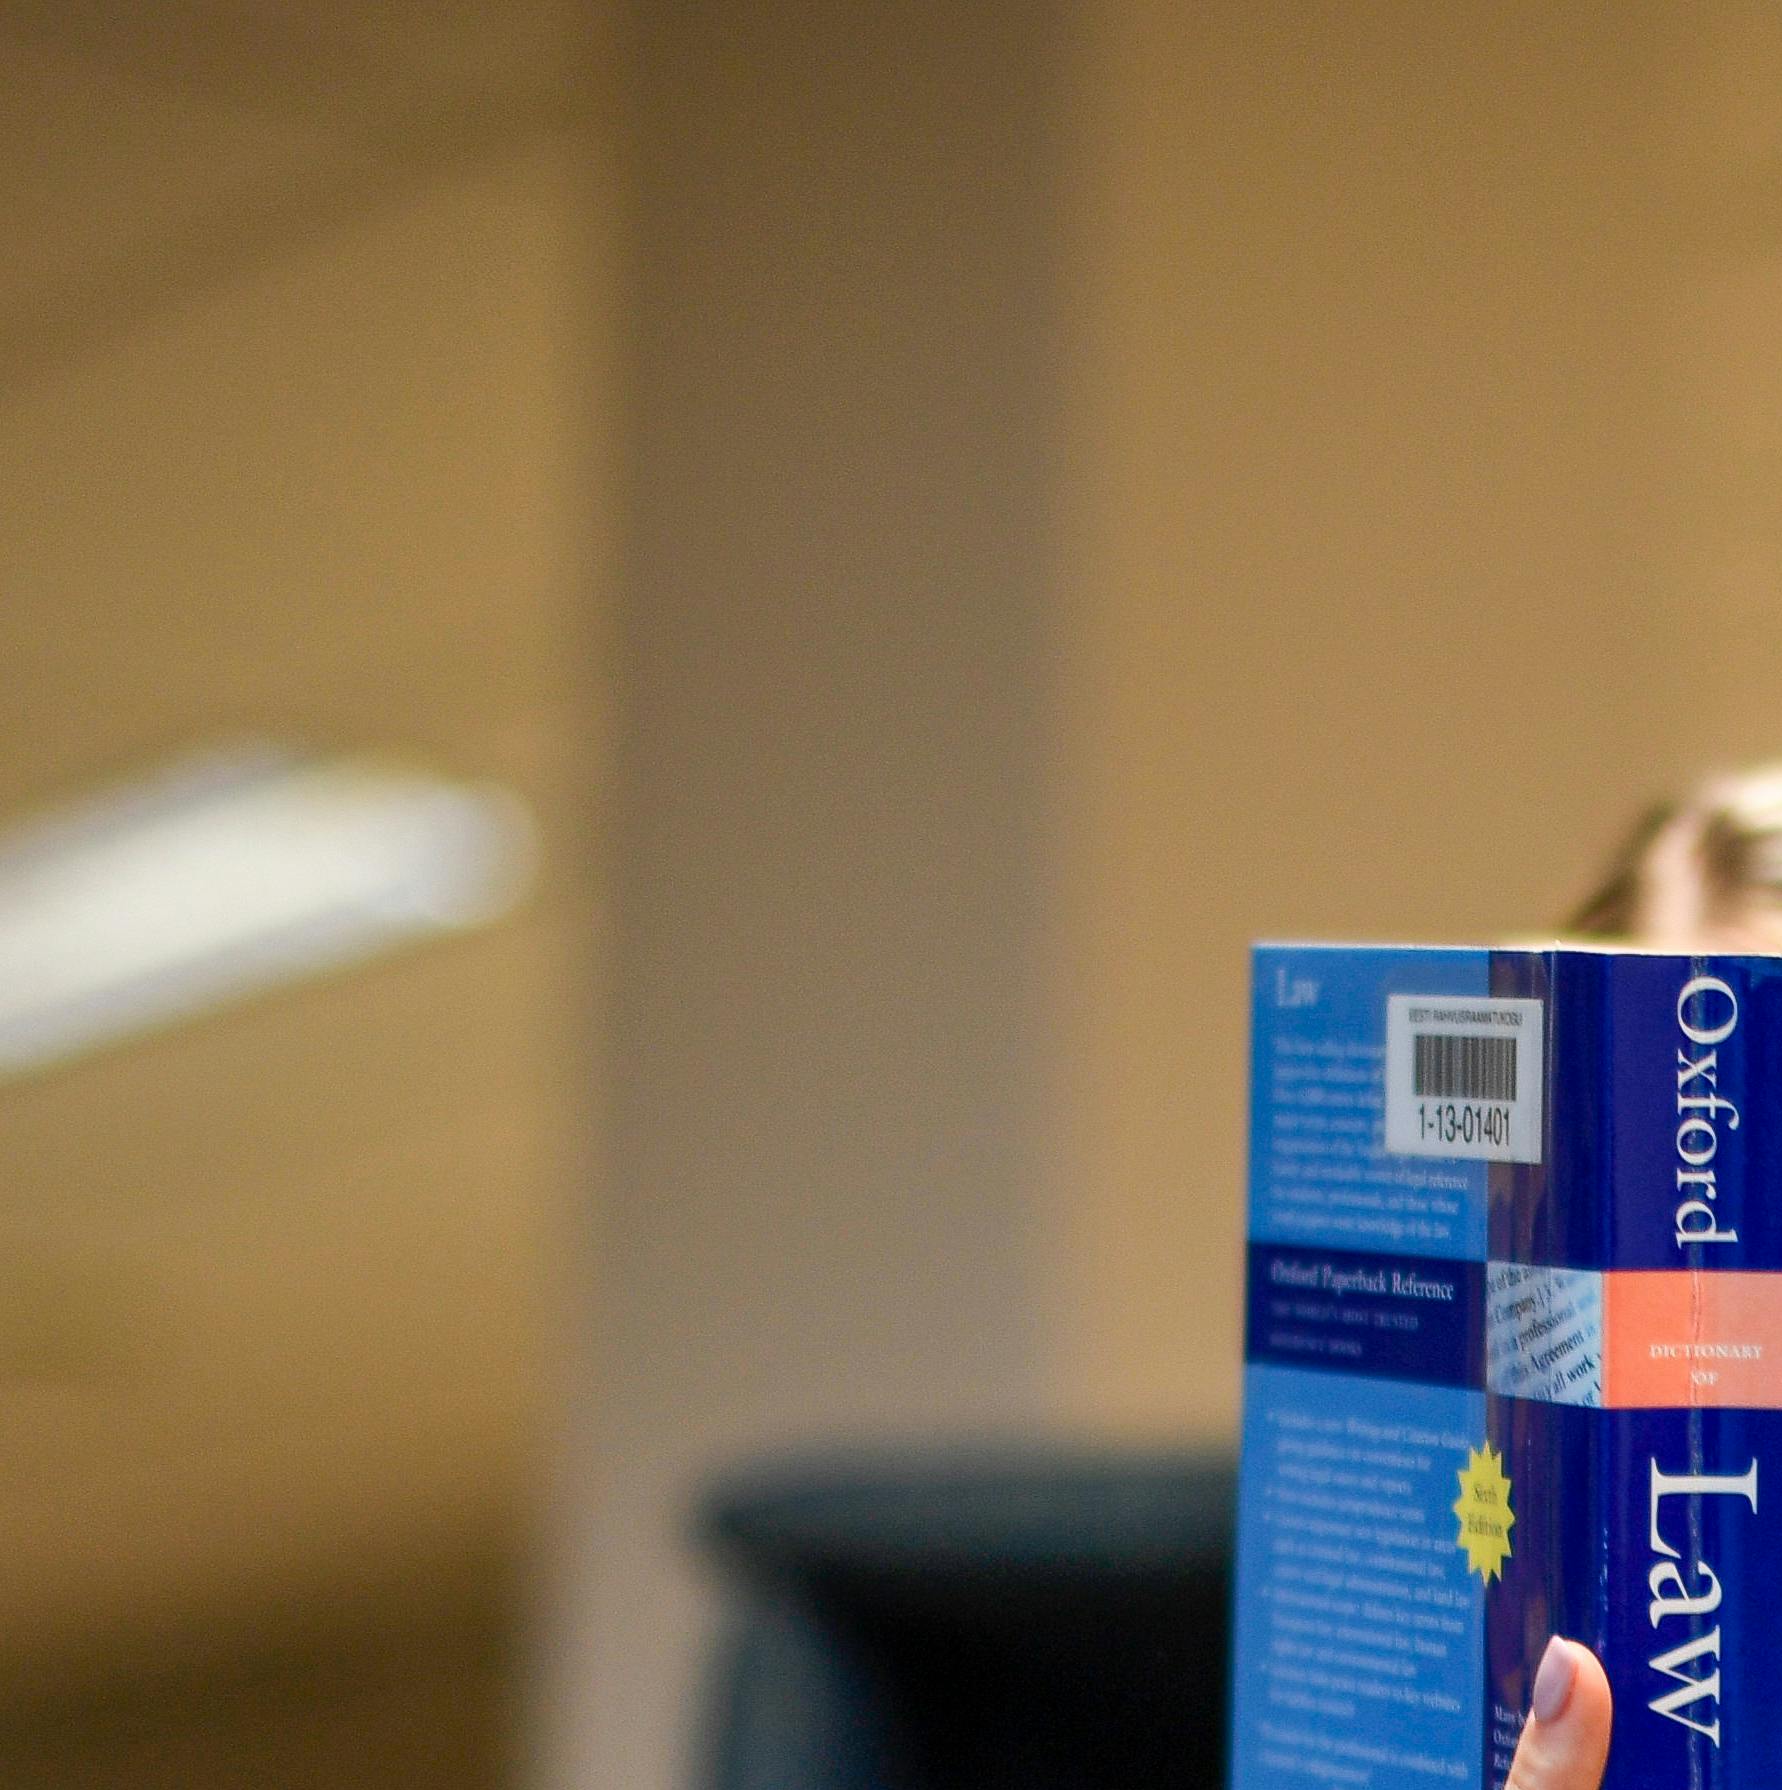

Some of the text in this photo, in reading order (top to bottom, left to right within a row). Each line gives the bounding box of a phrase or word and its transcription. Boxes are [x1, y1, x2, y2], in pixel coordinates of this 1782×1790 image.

[1278, 970, 1319, 1007] Law
[1419, 1103, 1510, 1147] 1-13-01401
[1674, 975, 1741, 1248] Oxford
[1322, 1264, 1387, 1296] Paperback
[1391, 1271, 1455, 1300] Reference
[1567, 1354, 1596, 1381] work
[1649, 1343, 1762, 1360] DICTIONARY
[1647, 1456, 1758, 1749] Law
